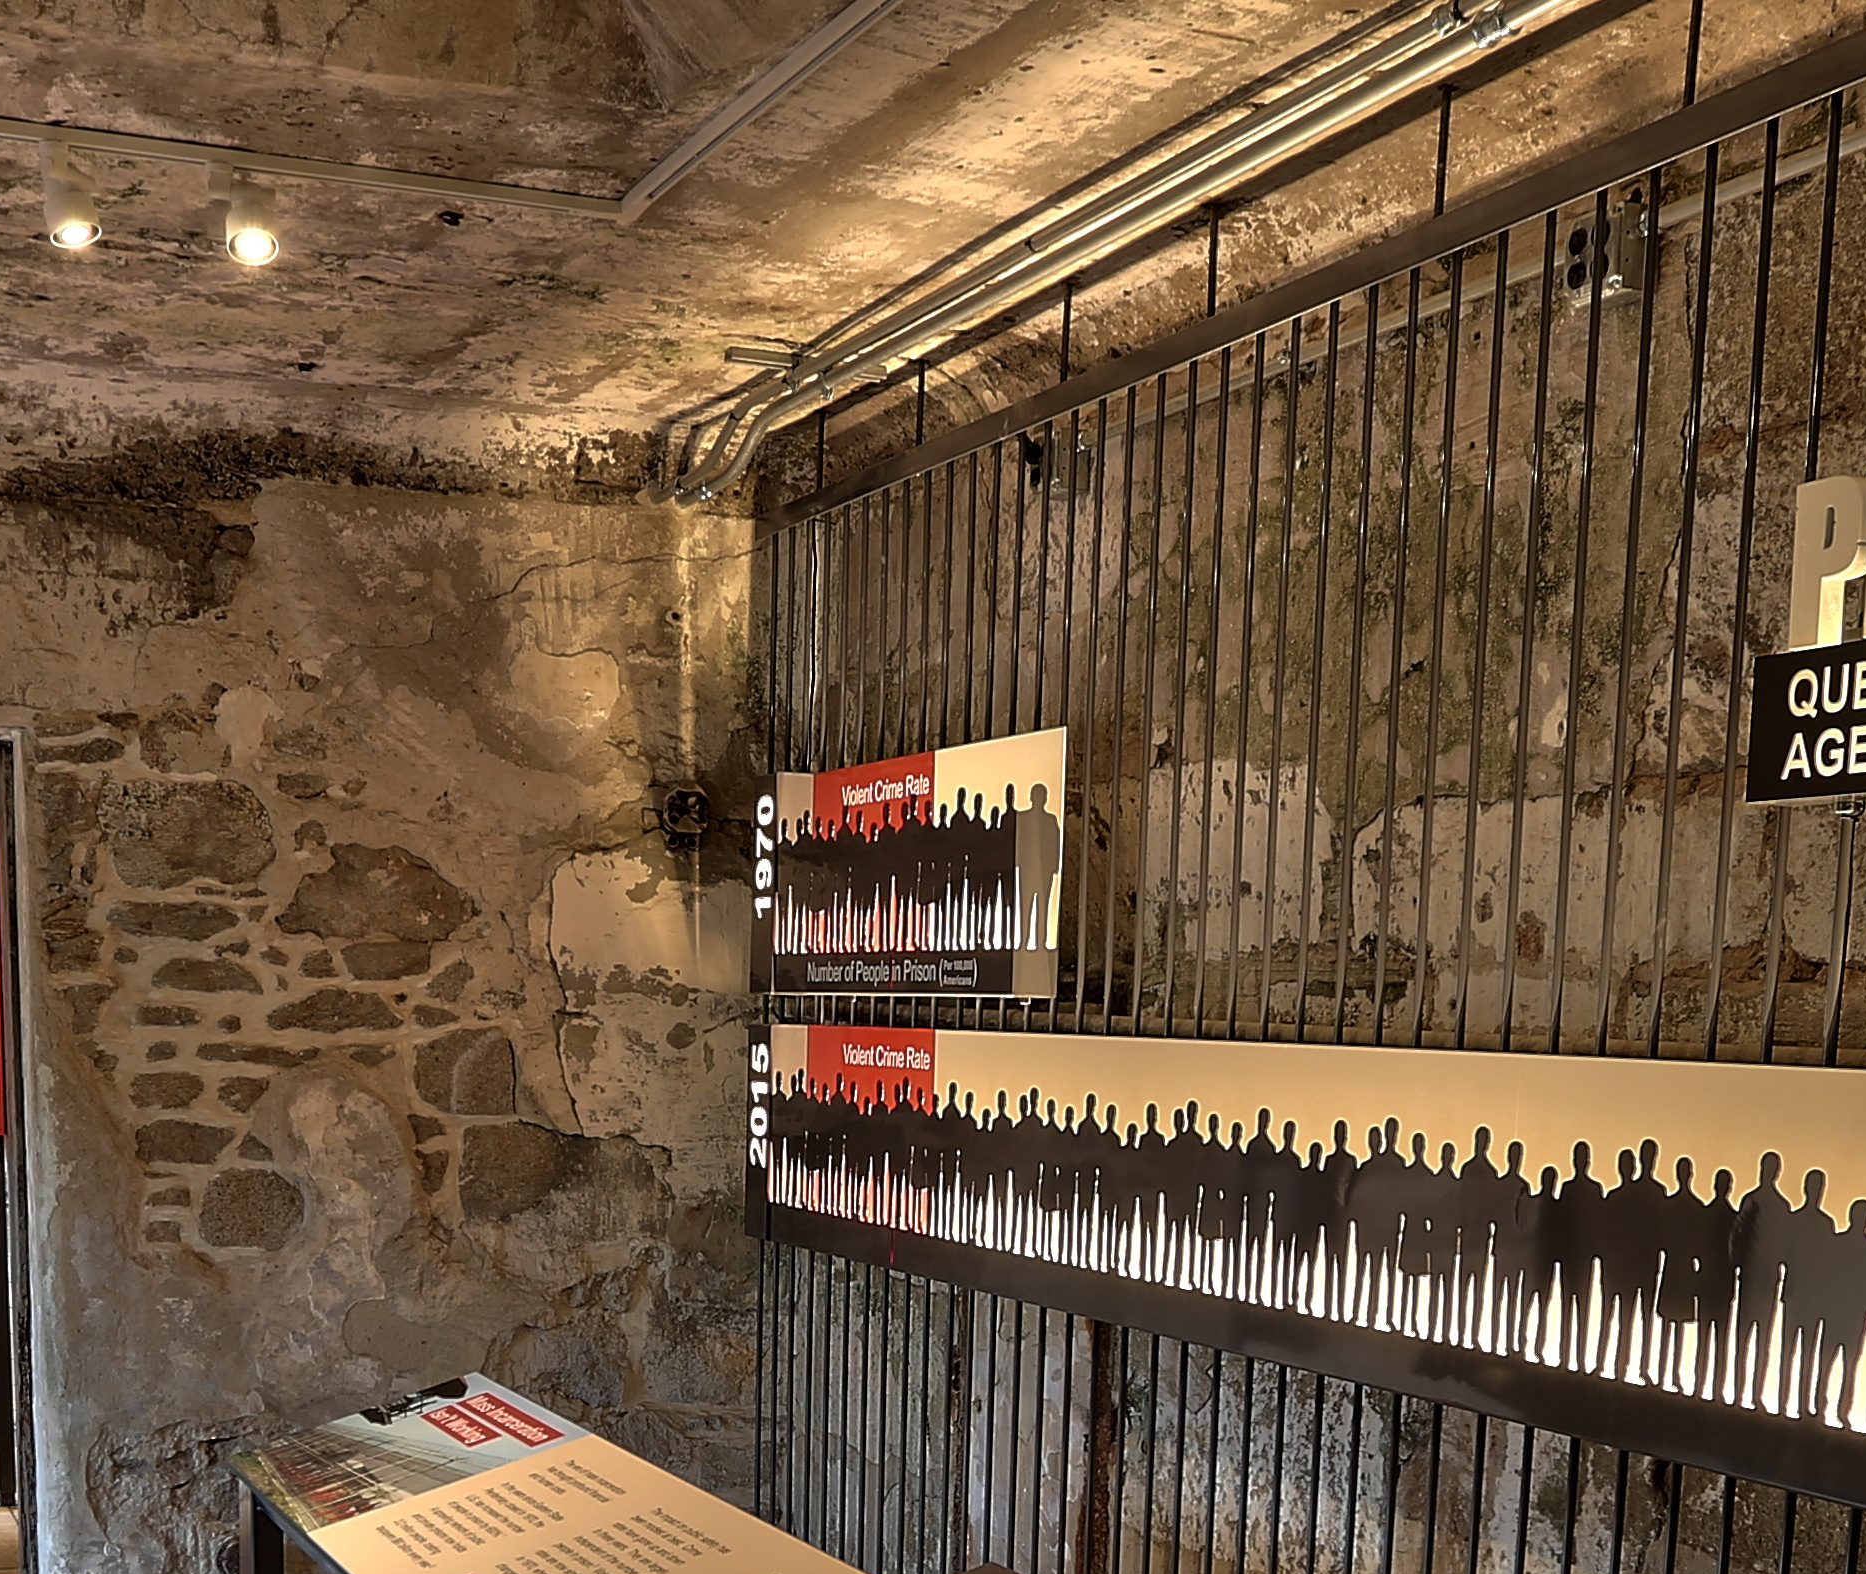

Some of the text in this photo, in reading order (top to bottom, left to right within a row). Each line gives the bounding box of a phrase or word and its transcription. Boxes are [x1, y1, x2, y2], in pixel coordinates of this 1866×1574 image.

[842, 774, 929, 805] Violent Crime Rate
[754, 794, 774, 919] 1970
[807, 961, 843, 982] Number
[844, 960, 854, 981] of
[856, 960, 889, 987] People
[891, 959, 900, 981] in
[903, 959, 936, 981] Prison
[843, 1044, 930, 1069] Violent Crime Rate
[750, 1043, 769, 1169] 2015
[429, 1408, 485, 1443] Isn't Working
[467, 1396, 547, 1442] Mass Incarceration
